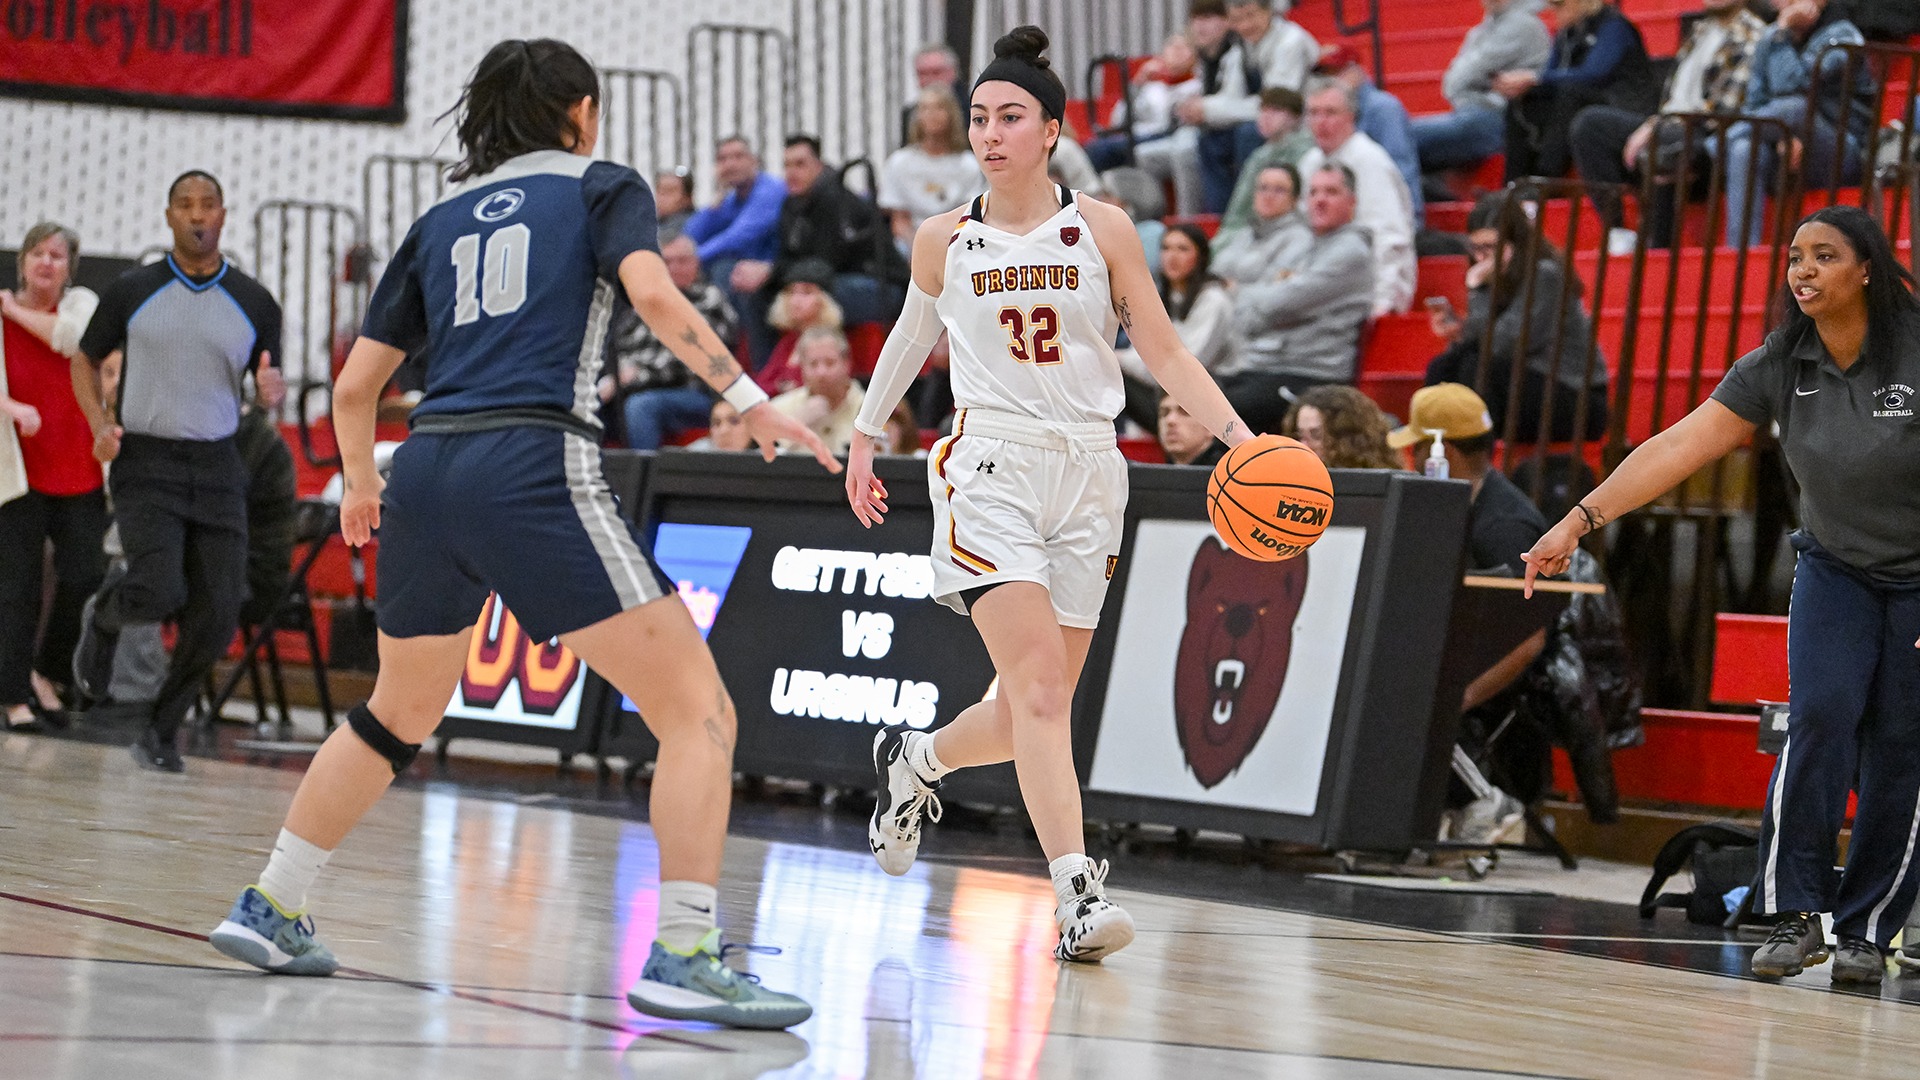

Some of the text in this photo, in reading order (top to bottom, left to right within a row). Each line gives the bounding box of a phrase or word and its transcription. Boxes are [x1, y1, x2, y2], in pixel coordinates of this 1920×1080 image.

[5, 0, 252, 65] olleyball
[451, 222, 531, 327] 10
[971, 265, 1079, 297] URSINUS
[997, 303, 1064, 367] 32
[1873, 409, 1913, 417] BASKETBALL
[1276, 500, 1328, 527] NCAA
[771, 545, 936, 599] GETTYSB
[841, 609, 894, 659] VS
[770, 667, 939, 729] URSINUS
